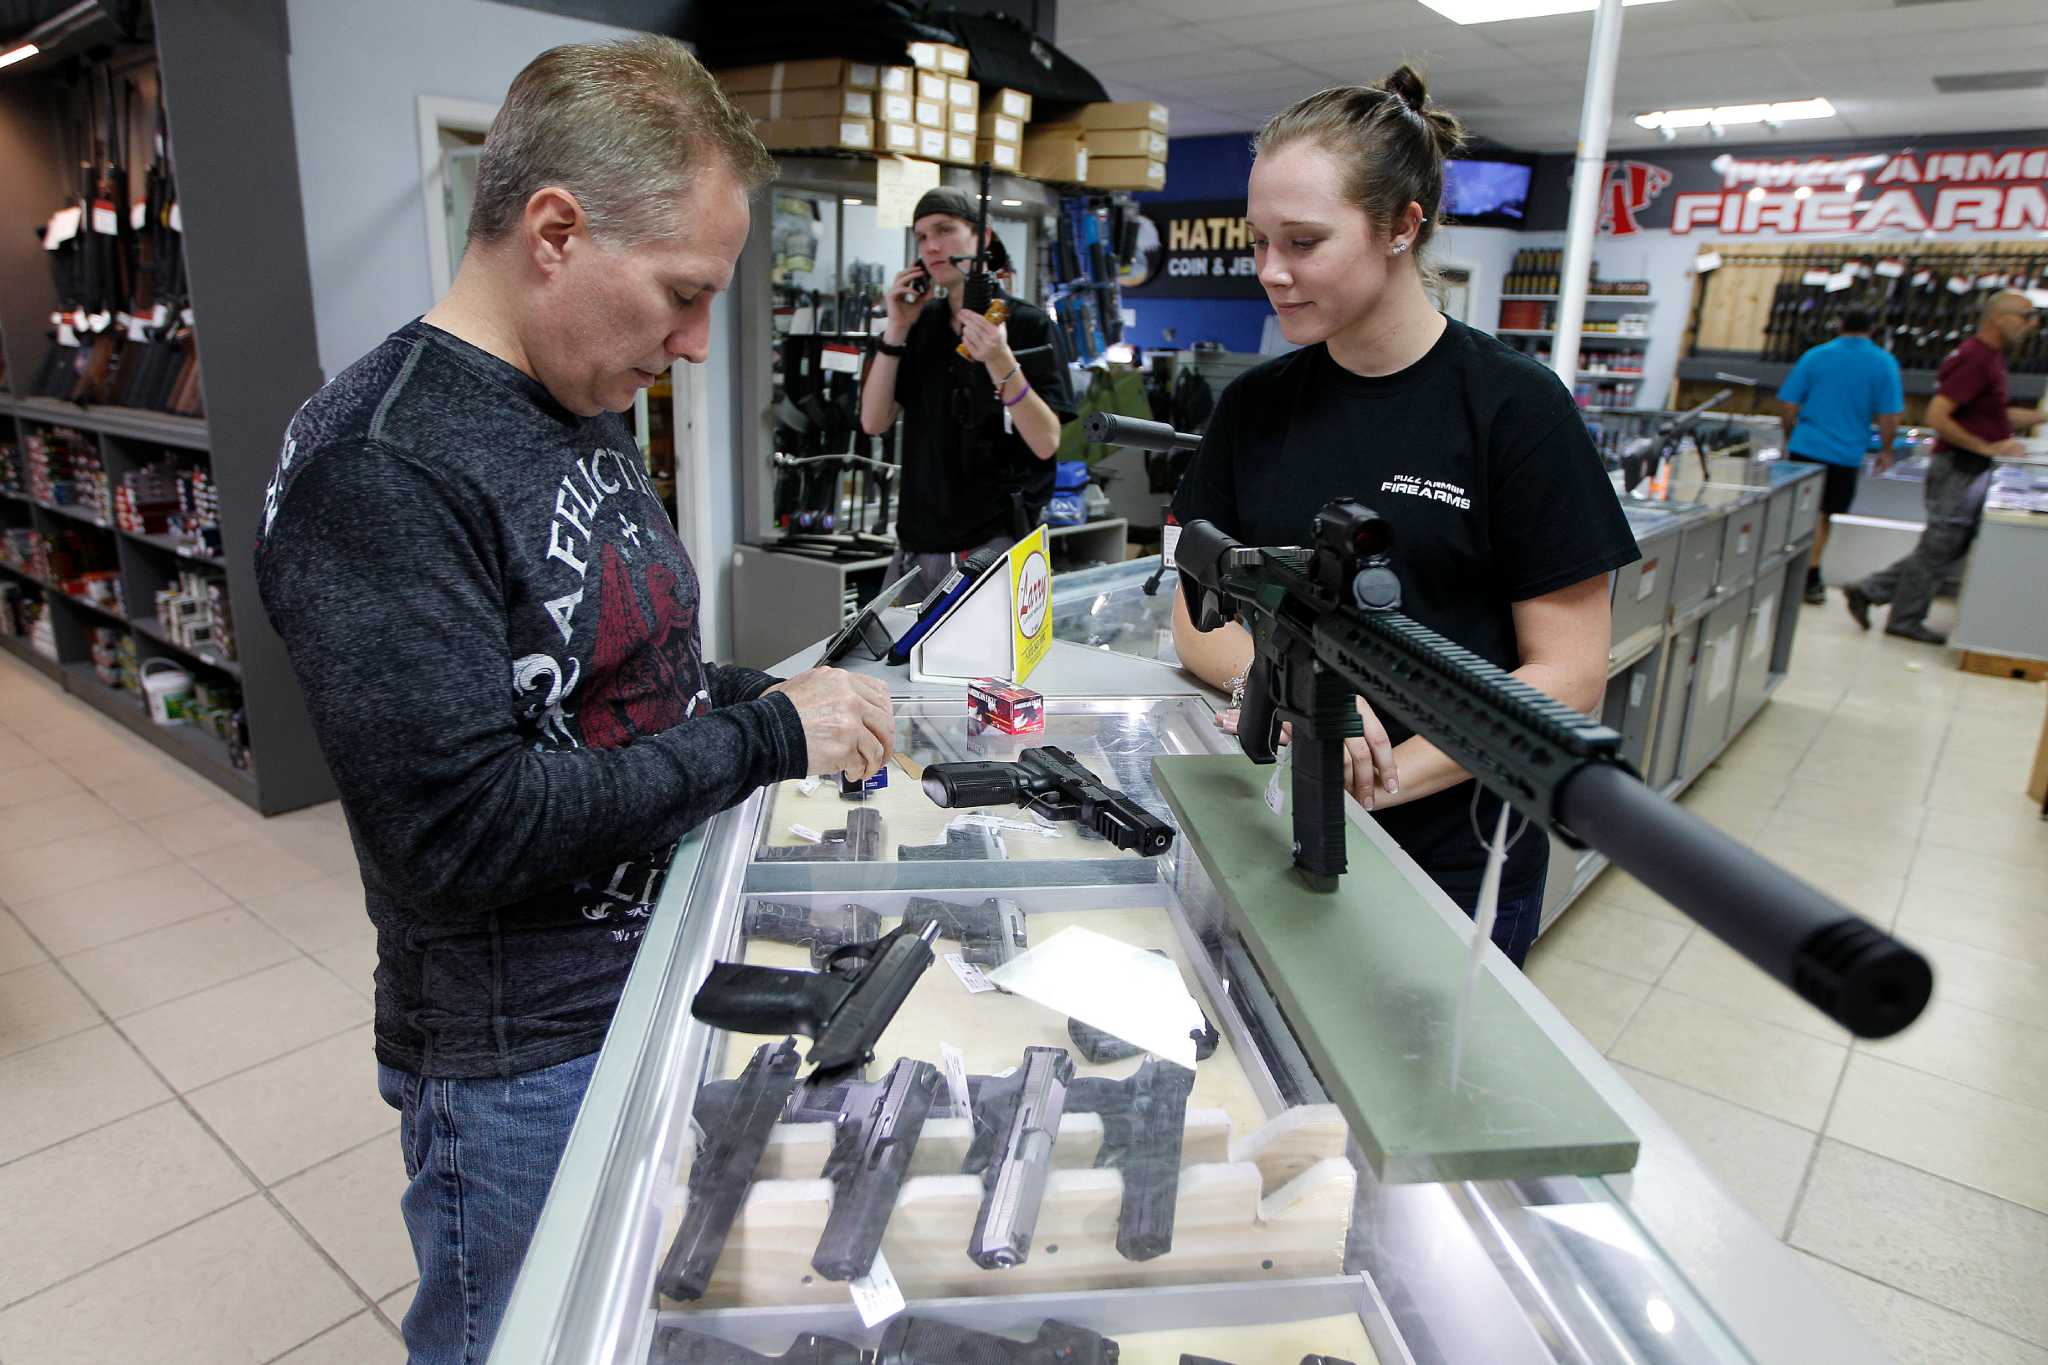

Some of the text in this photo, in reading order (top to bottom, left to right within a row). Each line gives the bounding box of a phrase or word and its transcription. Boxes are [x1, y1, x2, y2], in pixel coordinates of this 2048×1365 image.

[1168, 217, 1254, 251] HATH
[1168, 257, 1208, 276] COIN
[1212, 258, 1225, 275] &
[1394, 474, 1422, 484] FULL
[1381, 482, 1471, 509] FIREARMS
